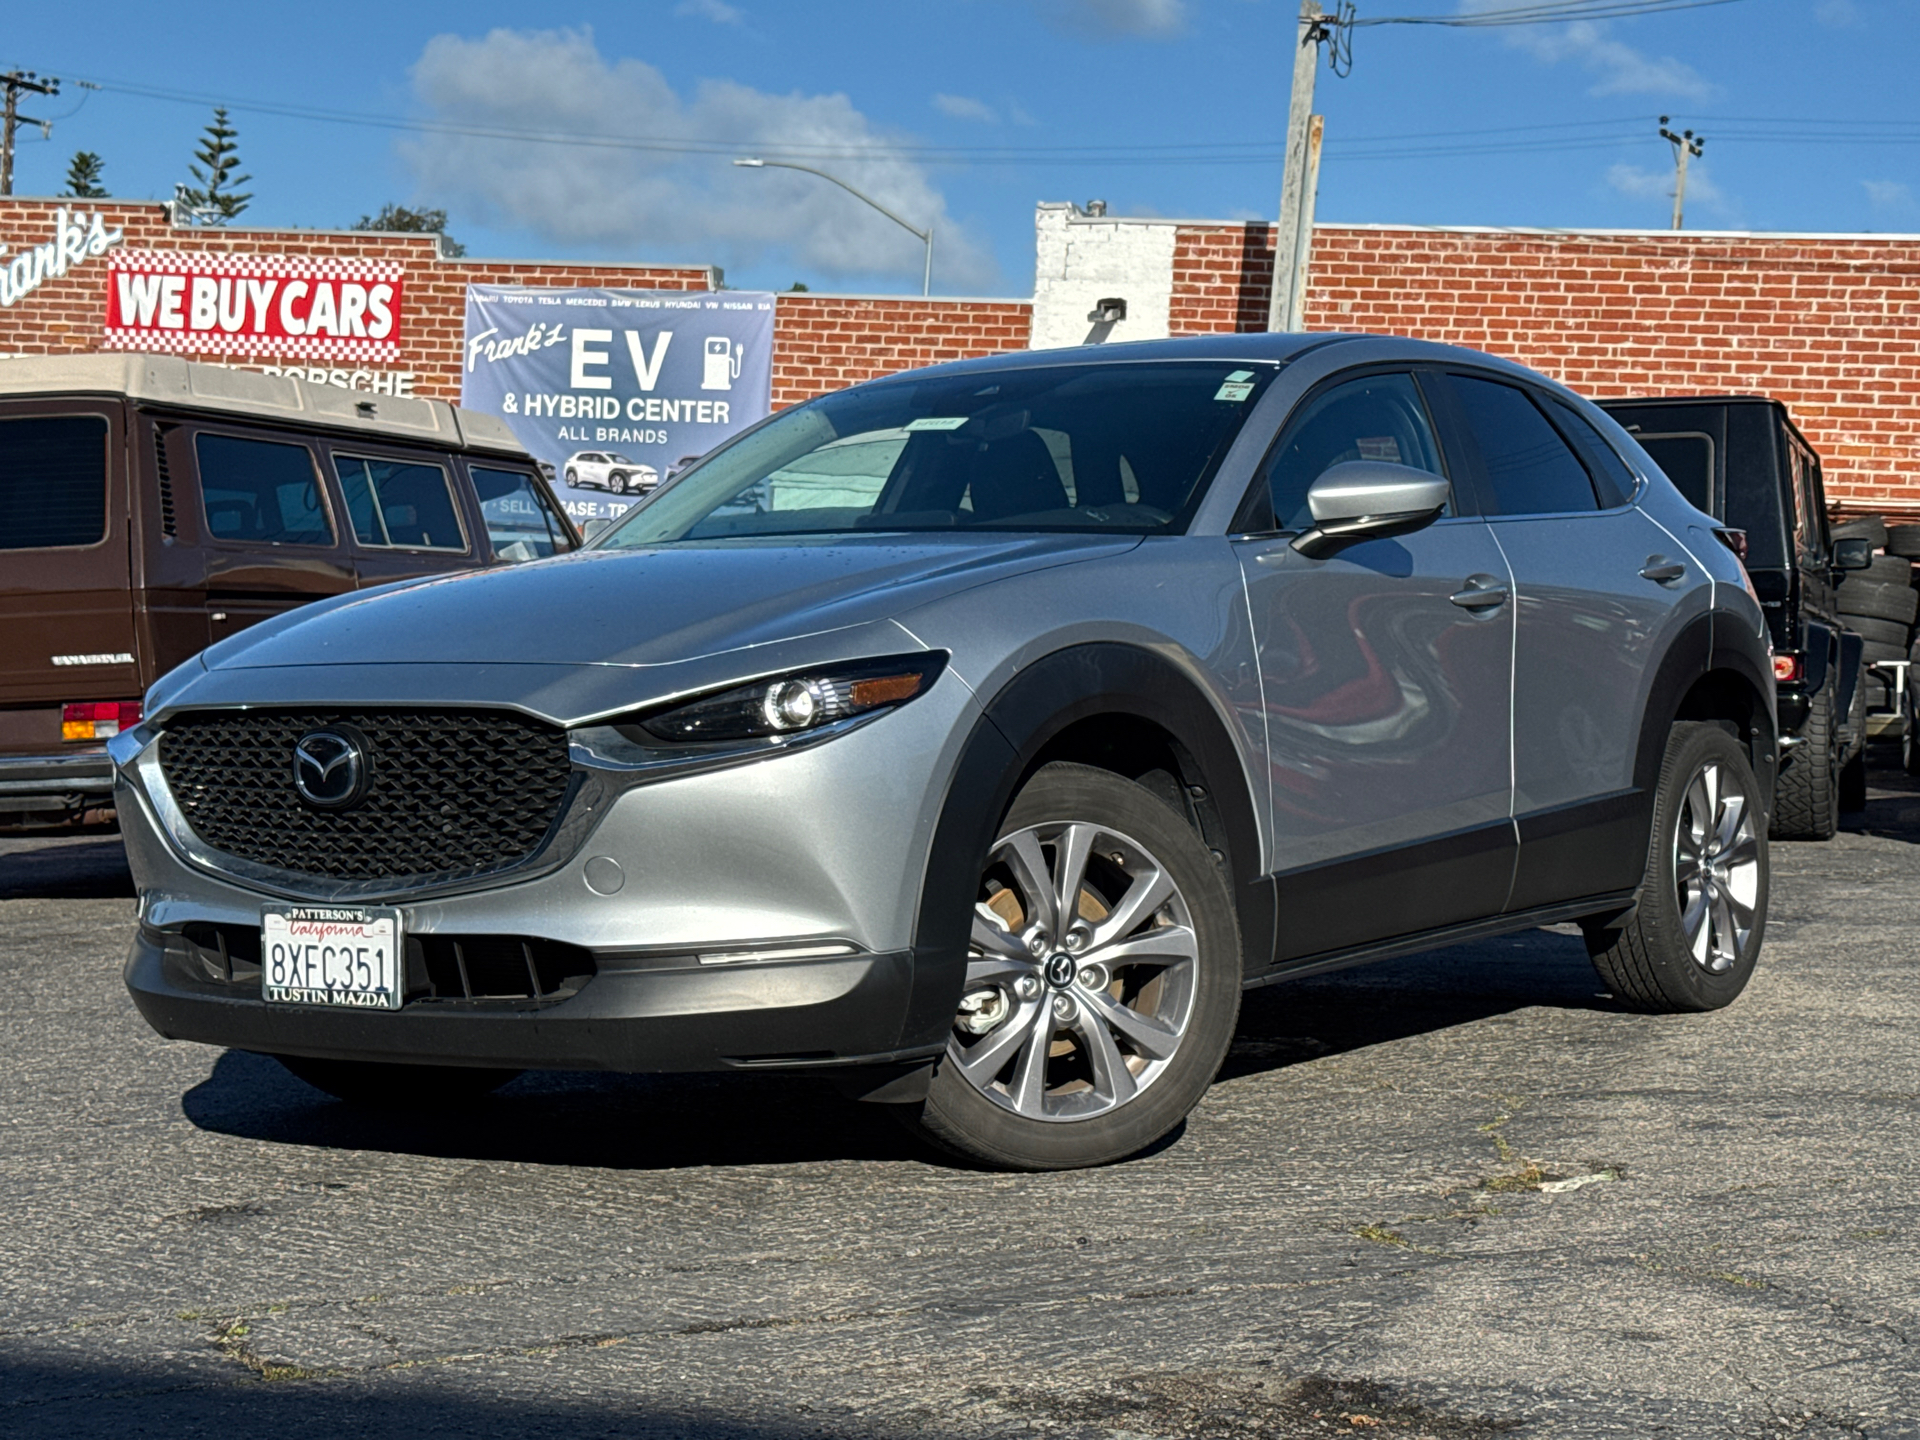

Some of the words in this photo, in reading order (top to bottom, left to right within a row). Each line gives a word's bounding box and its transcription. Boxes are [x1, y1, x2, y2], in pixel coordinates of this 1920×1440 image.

[117, 273, 186, 329] WE
[190, 276, 279, 334] BUY
[280, 279, 395, 340] CARS
[469, 294, 499, 303] SBARU
[503, 295, 534, 304] TOYOTA
[538, 296, 562, 305] TESLA
[566, 297, 607, 307] MERCEDES
[611, 299, 632, 308] BMW
[636, 300, 661, 309] LEXUS
[665, 300, 701, 309] HYUNDAI
[706, 301, 719, 310] VW
[723, 302, 753, 311] NISSAN
[758, 302, 771, 311] KIA
[468, 322, 567, 373] Frank's
[571, 327, 673, 392] EV
[502, 392, 519, 413] &
[524, 393, 620, 420] HYBRID
[626, 397, 731, 424] CENTER
[558, 425, 590, 442] ALL
[596, 427, 668, 444] BRANDS
[499, 499, 536, 515] SELL
[292, 908, 364, 922] PATTERSON'S
[290, 921, 373, 943] California
[272, 943, 389, 993] 8XFC351
[270, 986, 328, 1003] TUSTIN
[333, 990, 389, 1007] MAZDA
